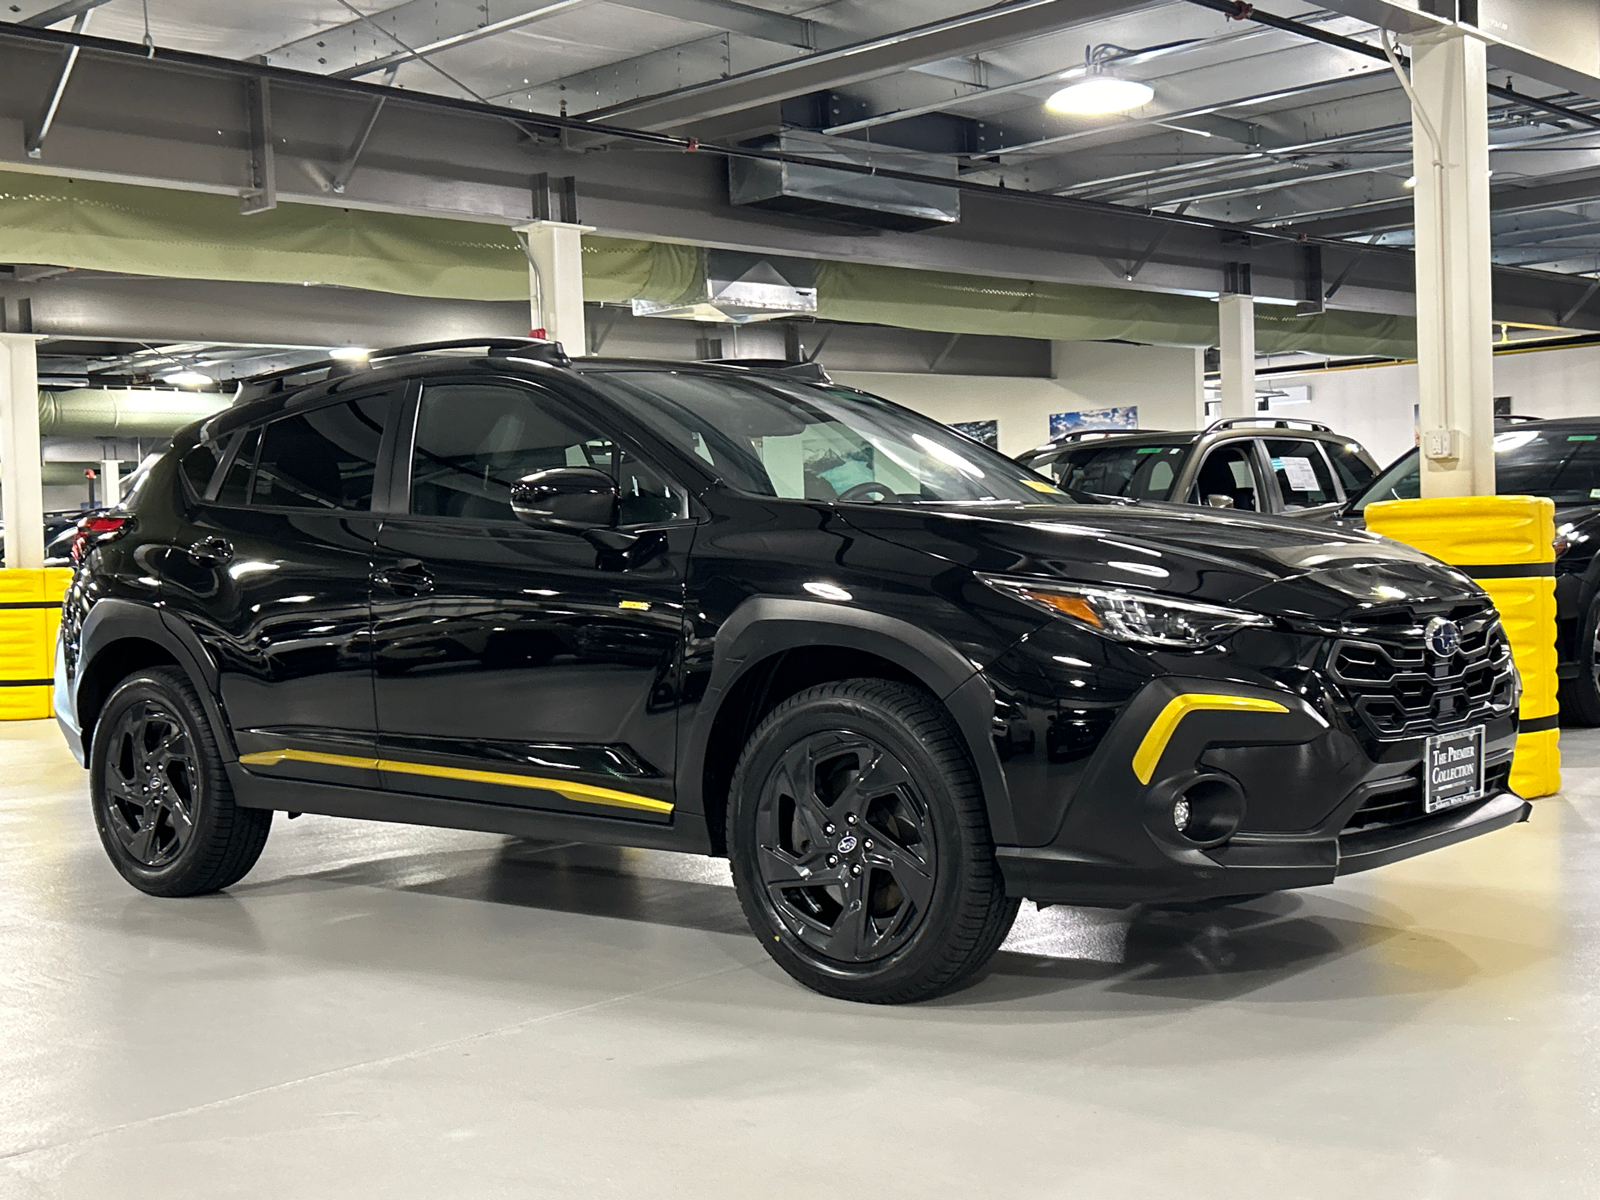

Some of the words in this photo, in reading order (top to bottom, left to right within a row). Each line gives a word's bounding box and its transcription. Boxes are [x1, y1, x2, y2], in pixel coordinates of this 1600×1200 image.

[1433, 750, 1447, 766] THE
[1448, 746, 1475, 762] PREMIER
[1432, 763, 1475, 784] COLLECTION
